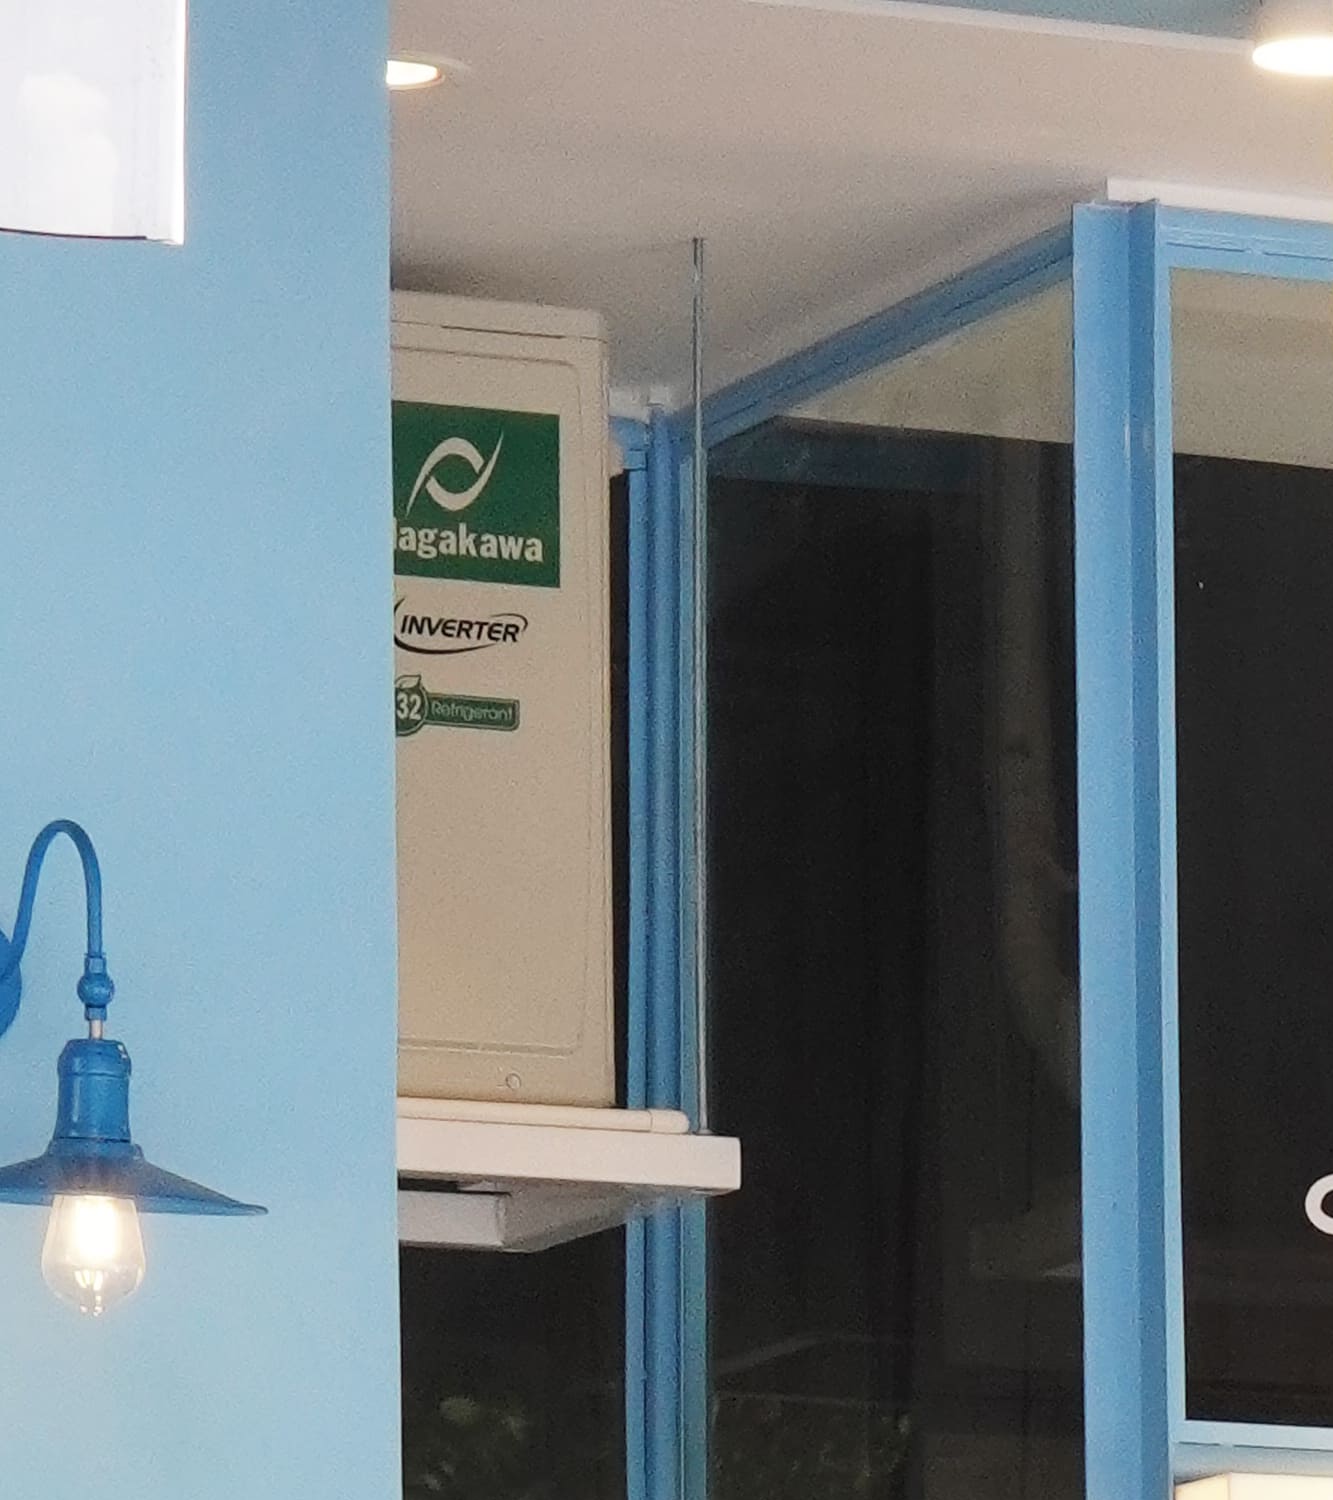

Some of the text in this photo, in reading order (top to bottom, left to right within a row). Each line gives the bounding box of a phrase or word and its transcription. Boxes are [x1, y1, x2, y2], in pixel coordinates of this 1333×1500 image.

[394, 518, 544, 564] agakawa
[400, 615, 519, 643] INVERTER
[430, 700, 513, 722] Refrigerant
